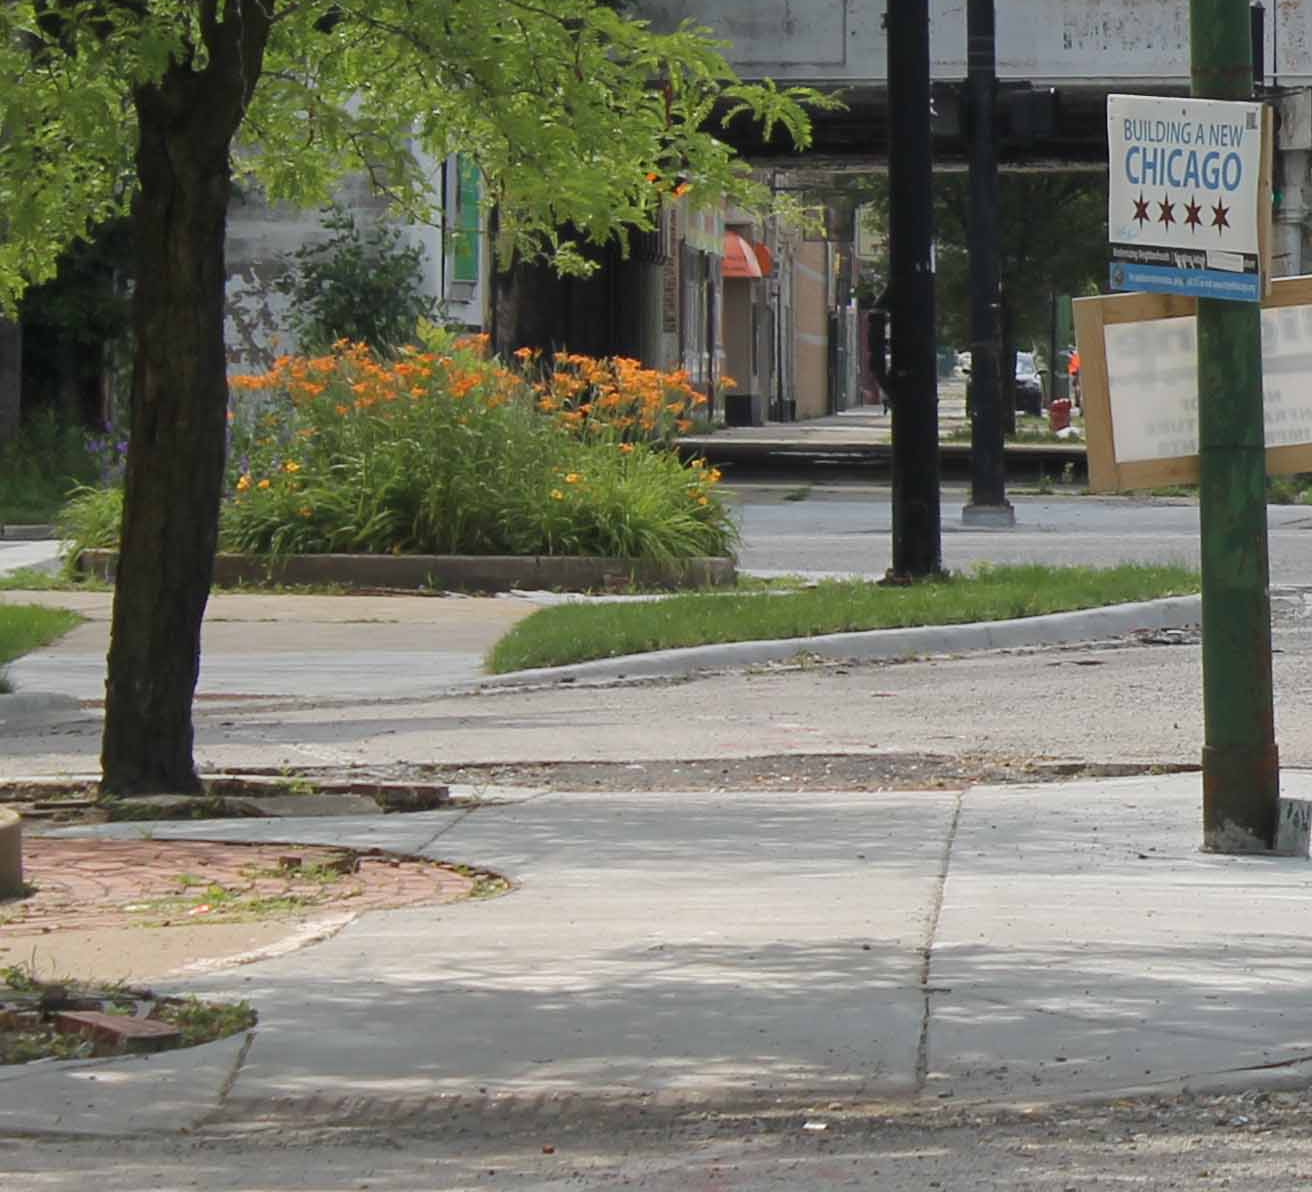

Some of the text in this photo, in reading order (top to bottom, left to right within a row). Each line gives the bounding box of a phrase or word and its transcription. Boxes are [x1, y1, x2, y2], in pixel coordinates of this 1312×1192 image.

[1124, 119, 1244, 147] BUILDING A NEW
[1125, 145, 1242, 191] CHICAGO
